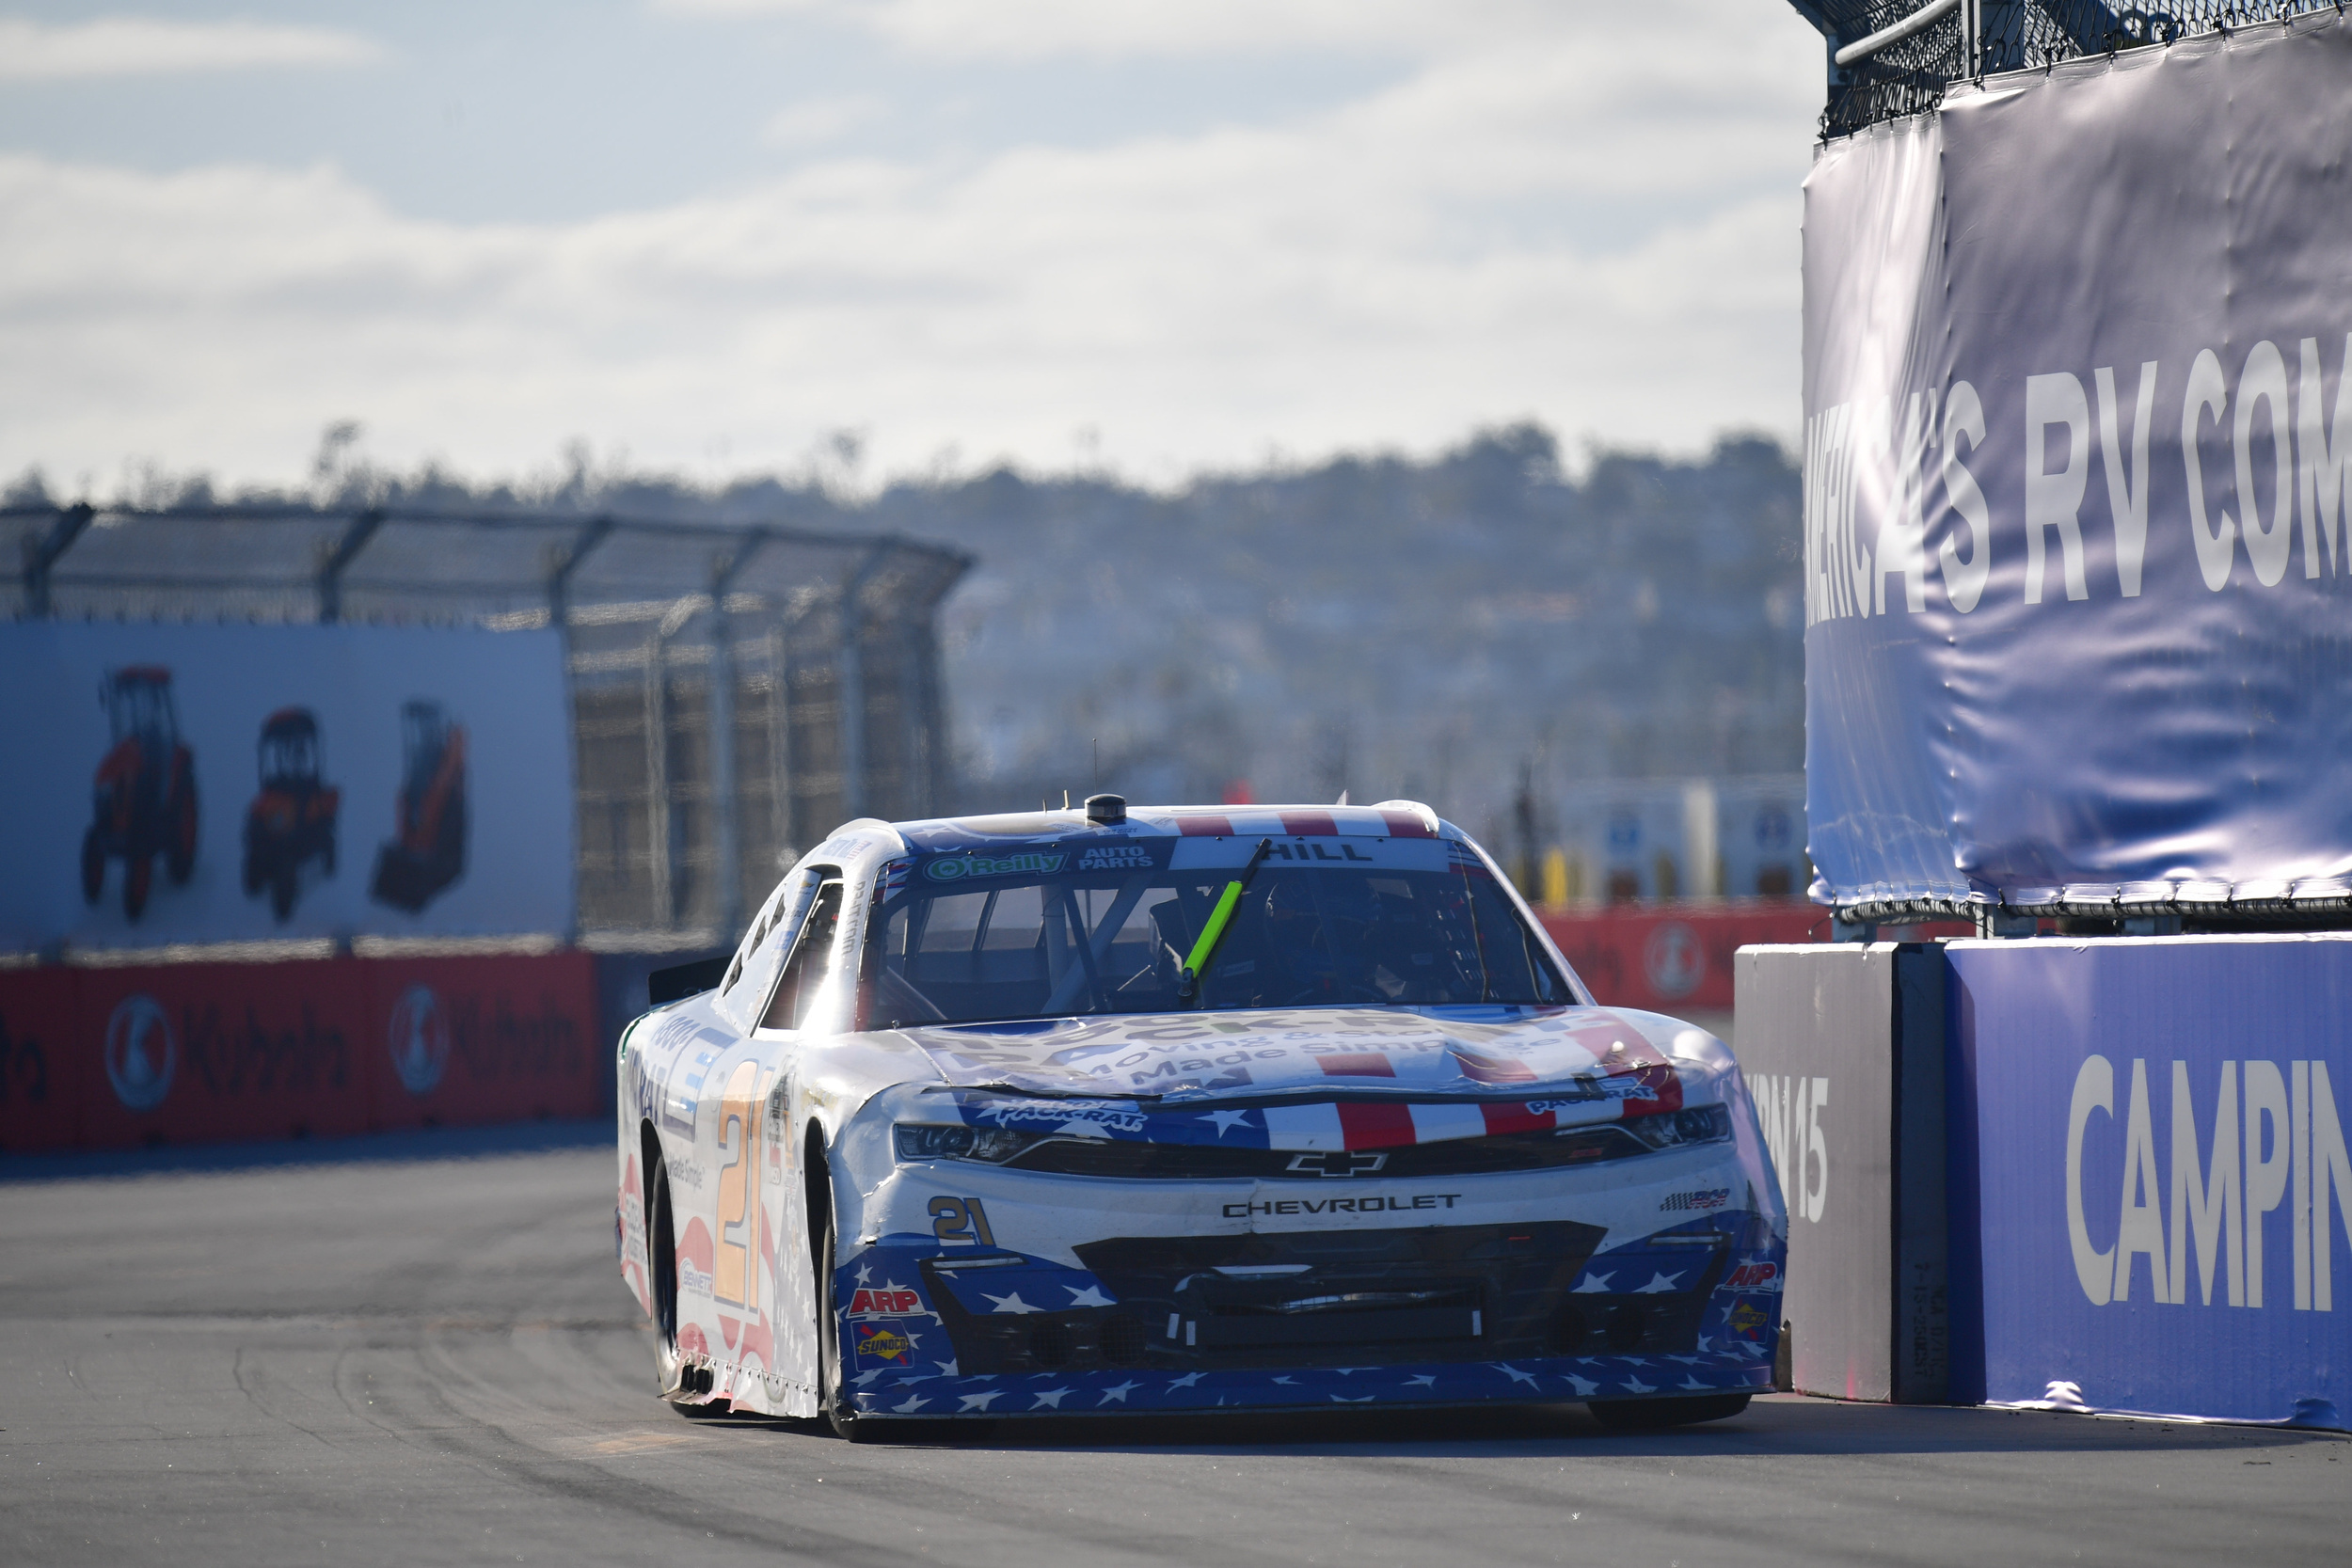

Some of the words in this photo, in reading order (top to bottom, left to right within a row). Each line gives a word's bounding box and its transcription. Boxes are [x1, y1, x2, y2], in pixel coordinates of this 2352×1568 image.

[1805, 380, 1991, 628] AMERICA'S
[2025, 360, 2158, 605] RV
[1078, 856, 1154, 870] PARTS
[1084, 846, 1145, 859] AUTO
[1255, 843, 1374, 862] HILL
[930, 852, 1060, 879] O'Reilly
[1129, 1048, 1287, 1086] Made
[999, 1106, 1149, 1128] PACK-RAT
[1795, 1076, 1829, 1223] 15
[713, 1057, 776, 1315] 21
[2066, 1053, 2352, 1313] CAMPIN
[1222, 1194, 1462, 1219] CHEVROLET
[927, 1196, 997, 1248] 21
[683, 1270, 712, 1289] BENNETT
[1725, 1262, 1777, 1286] ARP
[850, 1290, 918, 1313] ARP
[860, 1338, 907, 1354] SUNOCO
